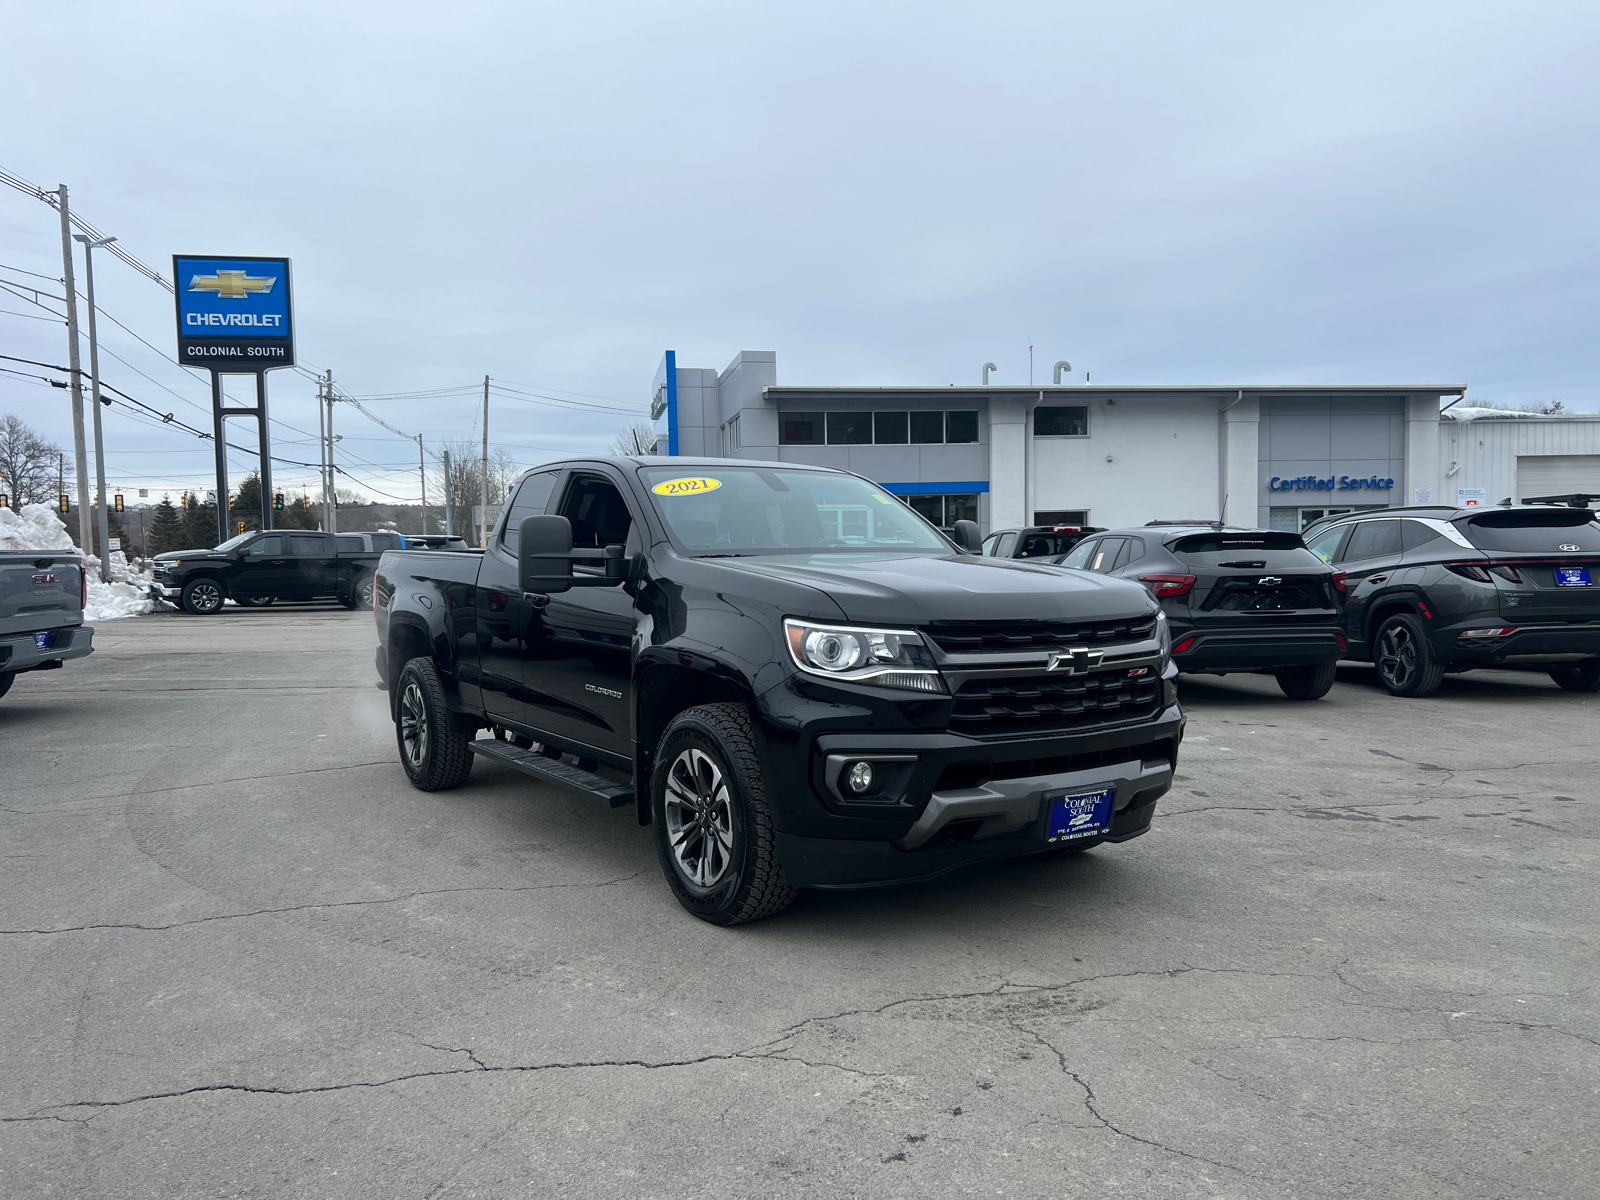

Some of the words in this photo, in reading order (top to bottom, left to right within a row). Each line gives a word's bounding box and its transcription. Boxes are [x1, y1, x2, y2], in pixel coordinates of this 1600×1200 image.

[186, 313, 282, 327] CHEVROLET
[187, 346, 243, 356] COLONIAL
[247, 347, 285, 356] SOUTH
[666, 479, 711, 494] 2021
[1270, 476, 1335, 491] Certified
[1340, 475, 1394, 490] Service
[32, 574, 60, 586] GMC
[585, 683, 623, 699] COLORADO
[1064, 796, 1102, 808] COLONIAL
[1070, 804, 1094, 816] SOUTH
